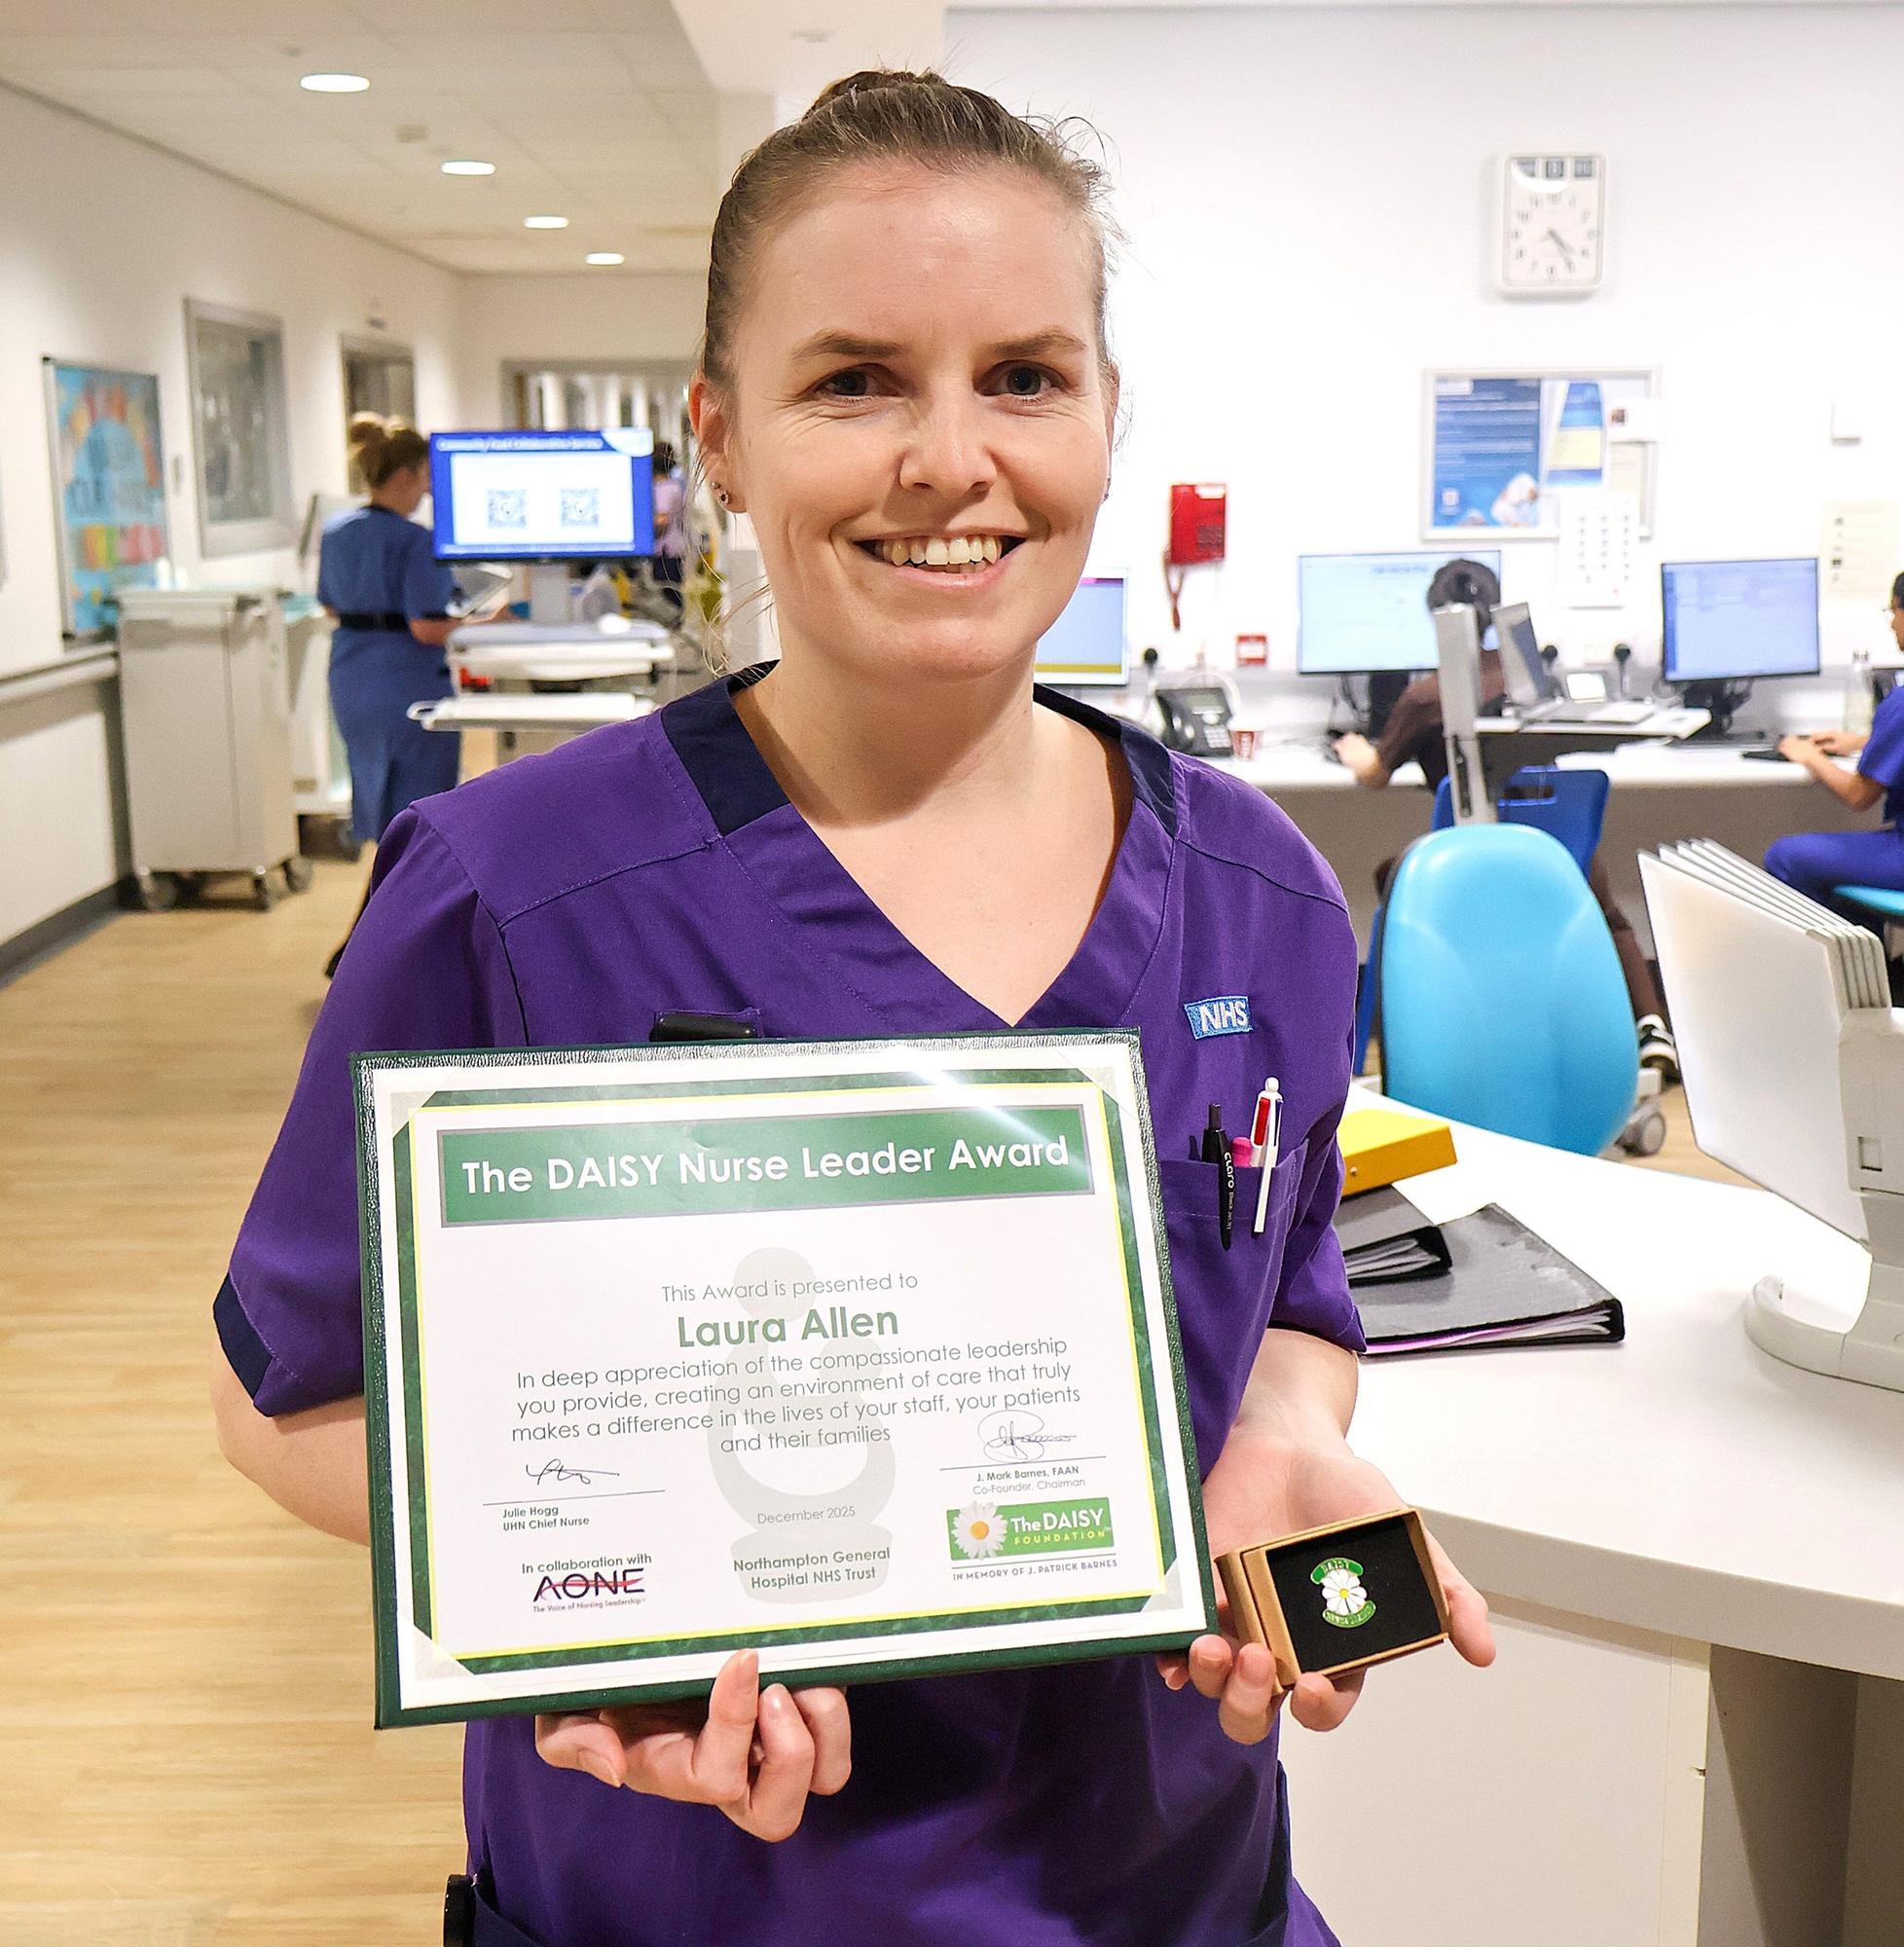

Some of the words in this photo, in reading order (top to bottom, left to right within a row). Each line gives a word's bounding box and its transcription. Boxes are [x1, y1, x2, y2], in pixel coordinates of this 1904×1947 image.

[1198, 1001, 1248, 1033] NHS
[462, 1160, 532, 1194] The
[548, 1153, 664, 1190] DAISY
[679, 1151, 787, 1185] Nurse
[802, 1142, 935, 1178] Leader
[949, 1135, 1068, 1170] Award
[662, 1285, 695, 1303] This
[703, 1280, 768, 1300] Award
[774, 1279, 786, 1296] is
[792, 1273, 892, 1299] presented
[898, 1272, 918, 1288] to
[677, 1316, 787, 1347] Laura
[801, 1306, 898, 1341] Allen
[518, 1373, 534, 1388] In
[542, 1370, 598, 1388] deep
[605, 1359, 738, 1388] appreciation
[745, 1356, 764, 1374] of
[771, 1355, 802, 1372] the
[810, 1345, 961, 1371] compassionate
[968, 1337, 1067, 1359] leadership
[517, 1400, 555, 1419] you
[564, 1390, 647, 1416] provide,
[655, 1385, 740, 1406] creating
[748, 1385, 773, 1399] an
[780, 1373, 903, 1397] environment
[911, 1371, 930, 1388] of
[936, 1372, 981, 1386] care
[988, 1364, 1025, 1382] that
[1033, 1362, 1071, 1381] truly
[512, 1422, 580, 1442] makes
[587, 1423, 600, 1436] a
[607, 1415, 714, 1435] difference
[720, 1410, 736, 1427] in
[744, 1408, 776, 1425] the
[783, 1406, 824, 1422] lives
[829, 1401, 849, 1419] of
[855, 1402, 897, 1421] your
[903, 1394, 949, 1414] staff,
[956, 1395, 998, 1414] your
[1005, 1387, 1080, 1408] patients
[720, 1433, 761, 1452] and
[768, 1430, 811, 1449] their
[818, 1425, 891, 1446] families
[977, 1473, 985, 1483] J.
[987, 1470, 1012, 1482] Mark
[1052, 1465, 1080, 1477] FAAN
[1037, 1478, 1086, 1490] Chairman
[502, 1507, 527, 1519] Julie
[530, 1506, 560, 1518] Hogg
[503, 1521, 526, 1532] UHN
[529, 1518, 558, 1530] Chief
[560, 1517, 591, 1527] Nurse
[757, 1509, 824, 1525] December
[826, 1505, 856, 1519] 2025
[1010, 1516, 1042, 1533] The
[1043, 1508, 1103, 1530] DAISY
[522, 1563, 533, 1574] In
[537, 1557, 623, 1572] collaboration
[627, 1553, 652, 1564] with
[734, 1554, 828, 1572] Northampton
[833, 1547, 890, 1563] General
[952, 1571, 965, 1582] IN
[966, 1568, 1009, 1580] MEMORY
[1011, 1566, 1025, 1577] OF
[1028, 1565, 1037, 1576] J.
[1039, 1561, 1079, 1574] PATRICK
[1080, 1559, 1118, 1570] BARNES
[532, 1567, 645, 1602] AONE
[751, 1572, 808, 1590] Hospital
[813, 1569, 841, 1584] NHS
[845, 1566, 875, 1580] Trust
[568, 1602, 576, 1611] of
